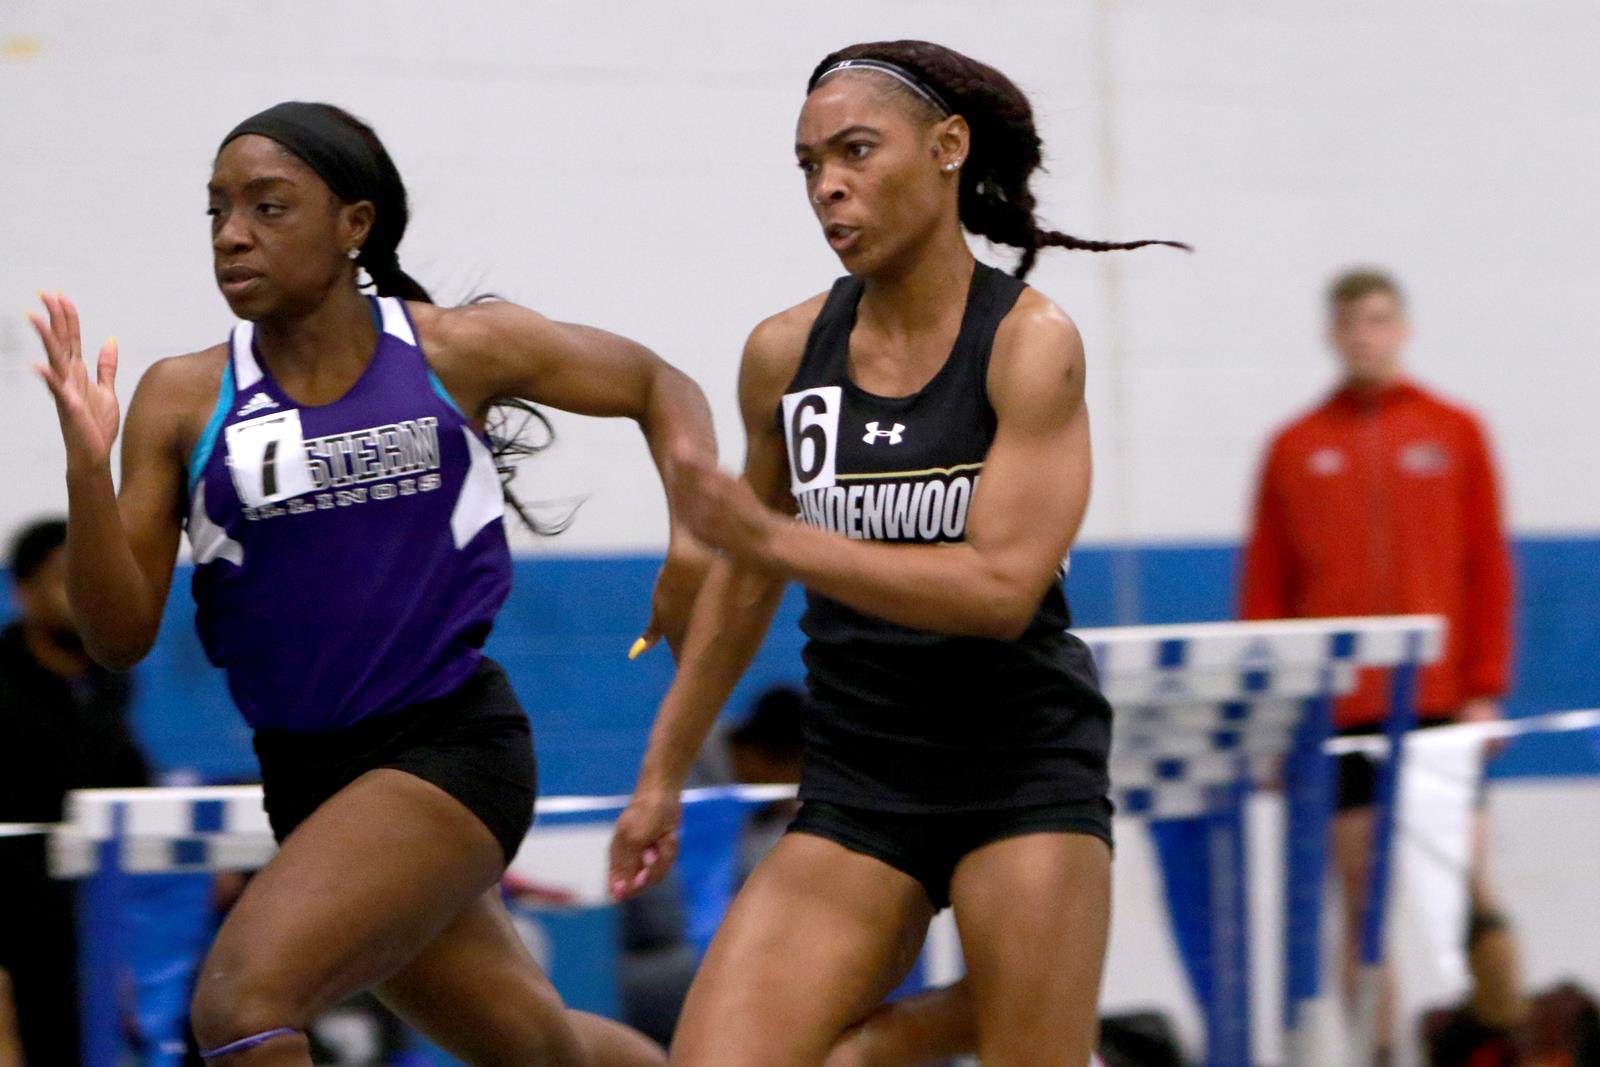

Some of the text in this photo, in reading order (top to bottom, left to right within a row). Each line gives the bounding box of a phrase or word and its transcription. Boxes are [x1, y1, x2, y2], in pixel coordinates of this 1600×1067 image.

[303, 416, 439, 489] STERN
[792, 394, 827, 484] 6
[241, 473, 441, 521] ILLINOIS
[797, 475, 981, 540] INDENWOO
